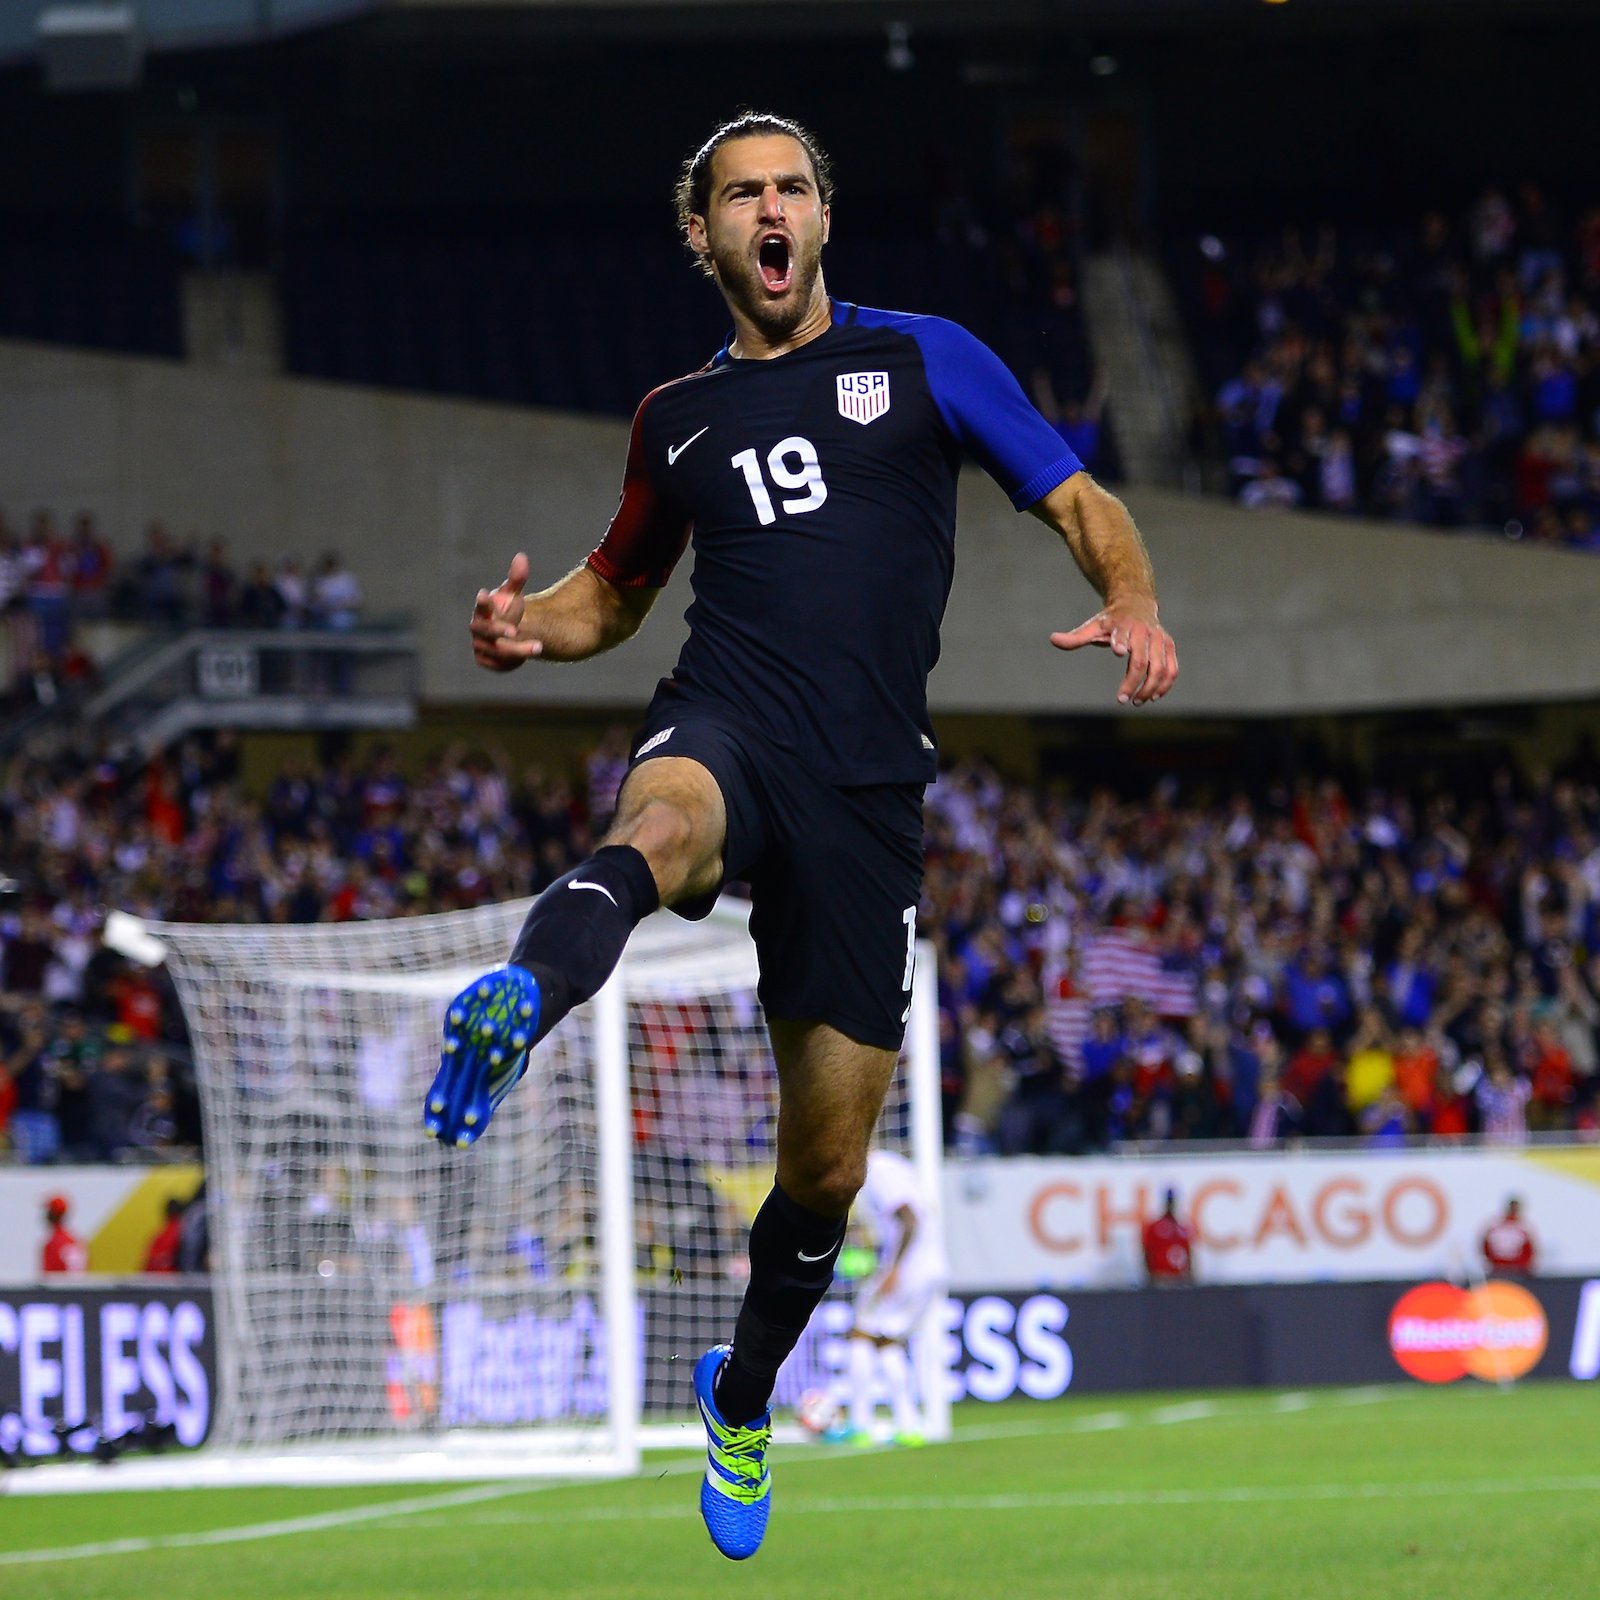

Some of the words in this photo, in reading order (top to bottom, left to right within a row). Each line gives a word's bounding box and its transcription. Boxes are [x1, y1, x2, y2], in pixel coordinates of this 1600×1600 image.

[841, 375, 884, 395] USA
[731, 436, 828, 526] 19
[902, 905, 917, 1023] 1
[1028, 1176, 1450, 1254] CHCAGO
[0, 1303, 209, 1453] ELESS
